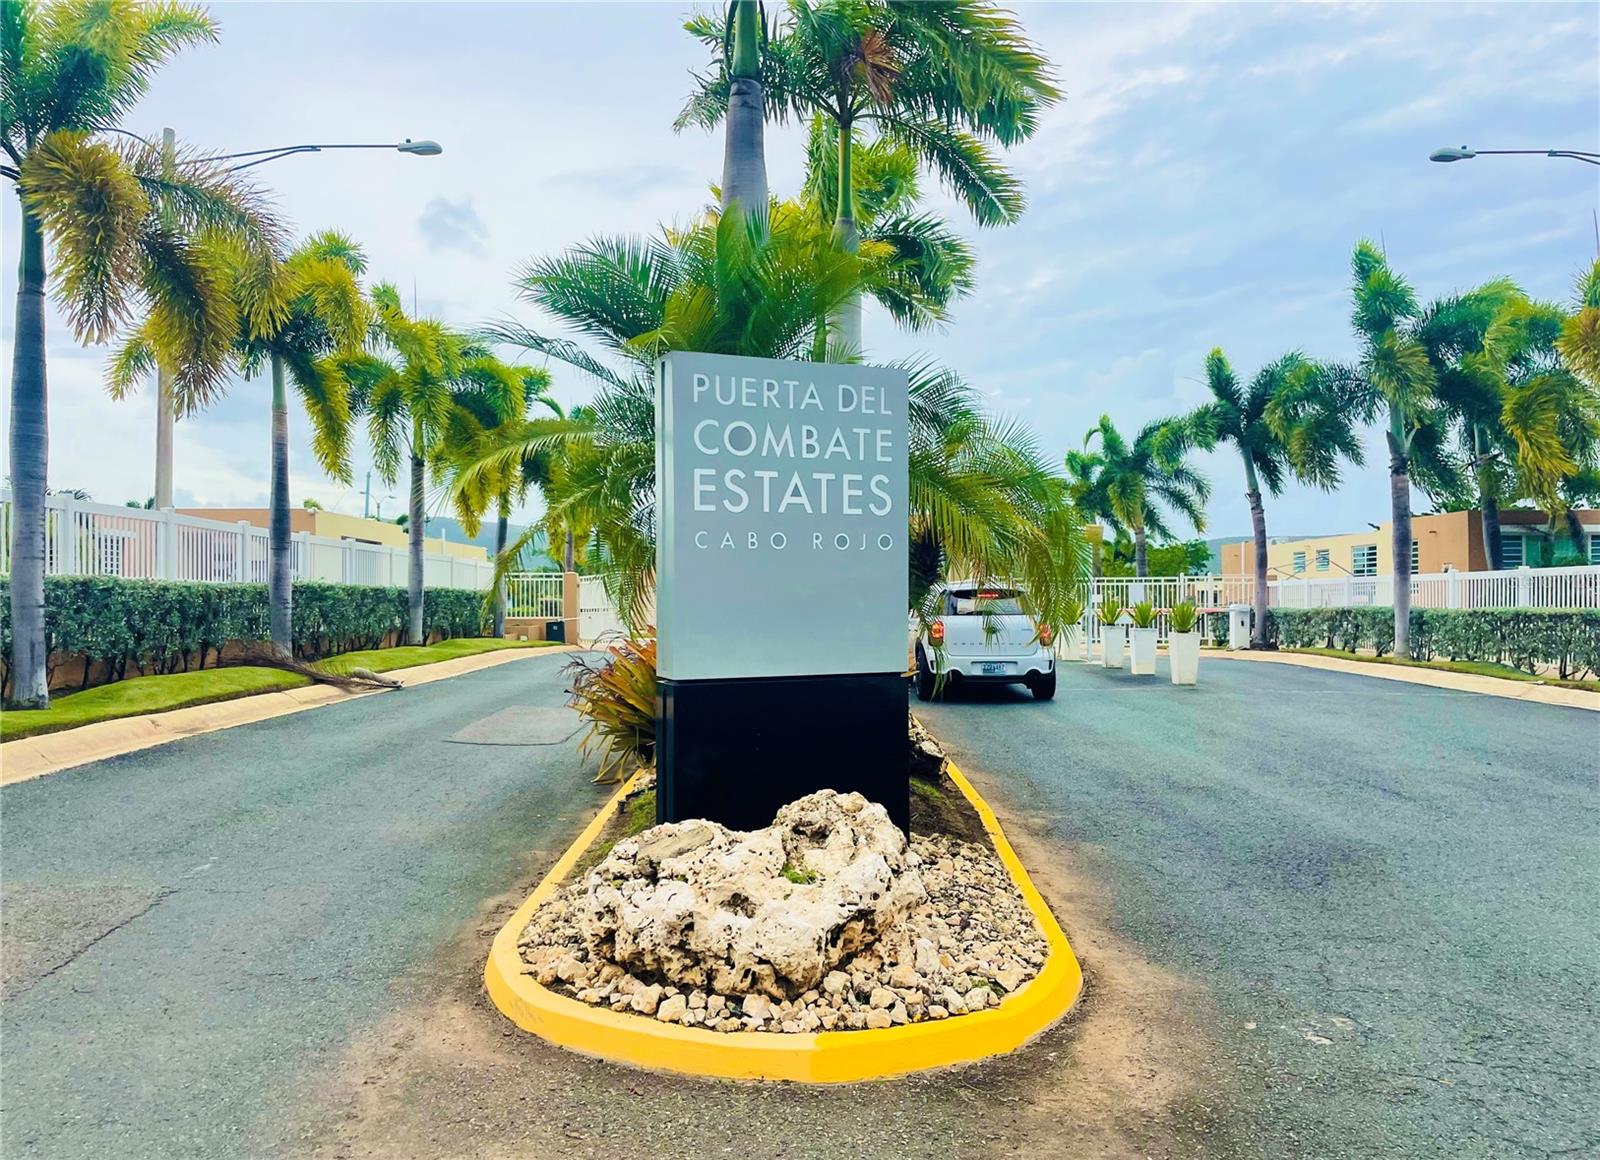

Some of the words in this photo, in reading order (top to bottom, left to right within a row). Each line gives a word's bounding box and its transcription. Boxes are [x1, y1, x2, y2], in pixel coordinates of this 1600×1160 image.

[693, 373, 824, 411] PUERTA
[838, 384, 893, 416] DEL
[693, 419, 893, 462] COMBATE
[693, 468, 893, 517] ESTATES
[694, 531, 787, 550] CABO
[812, 532, 893, 551] ROJO
